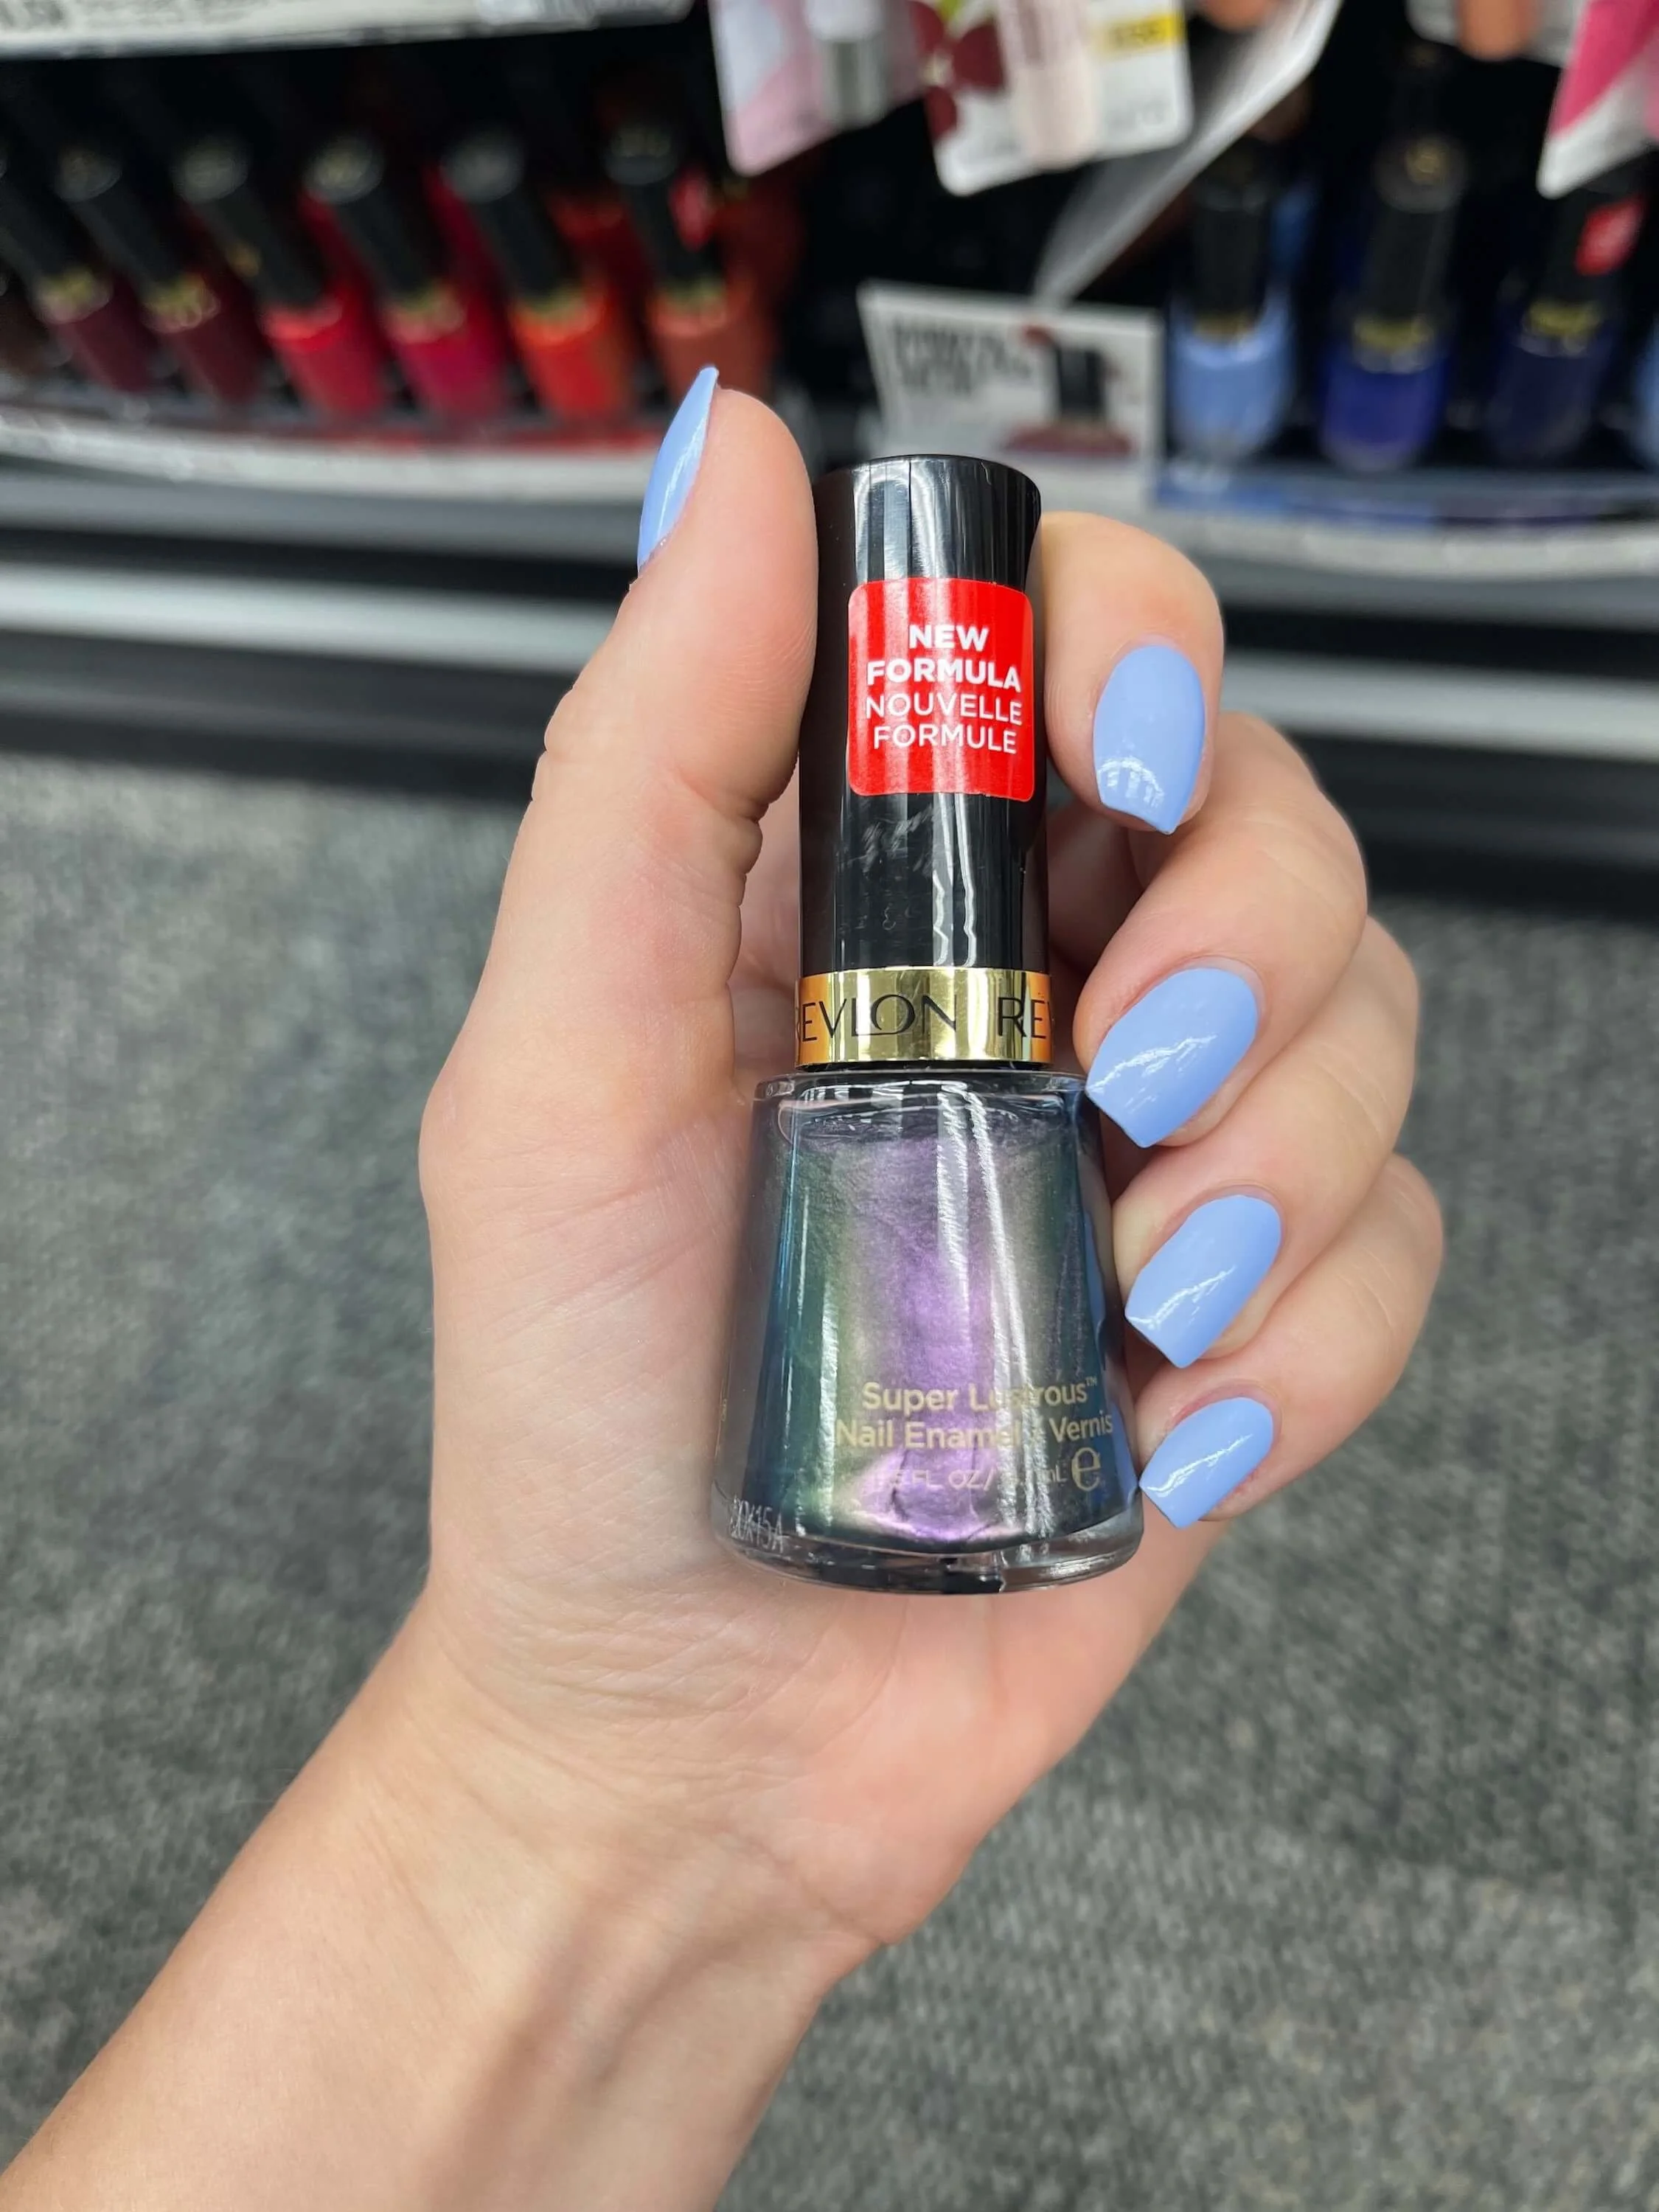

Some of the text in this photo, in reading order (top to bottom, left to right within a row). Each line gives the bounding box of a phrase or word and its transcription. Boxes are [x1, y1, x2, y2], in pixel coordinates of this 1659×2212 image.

[908, 624, 990, 652] NEW
[866, 658, 1021, 692] FORMULA
[865, 693, 1023, 726] NOUVELLE
[874, 725, 1018, 754] FORMULE
[801, 994, 1052, 1042] EVLON RE
[860, 1380, 958, 1415] Super
[835, 1409, 1114, 1449] Nail Enamel Vernis
